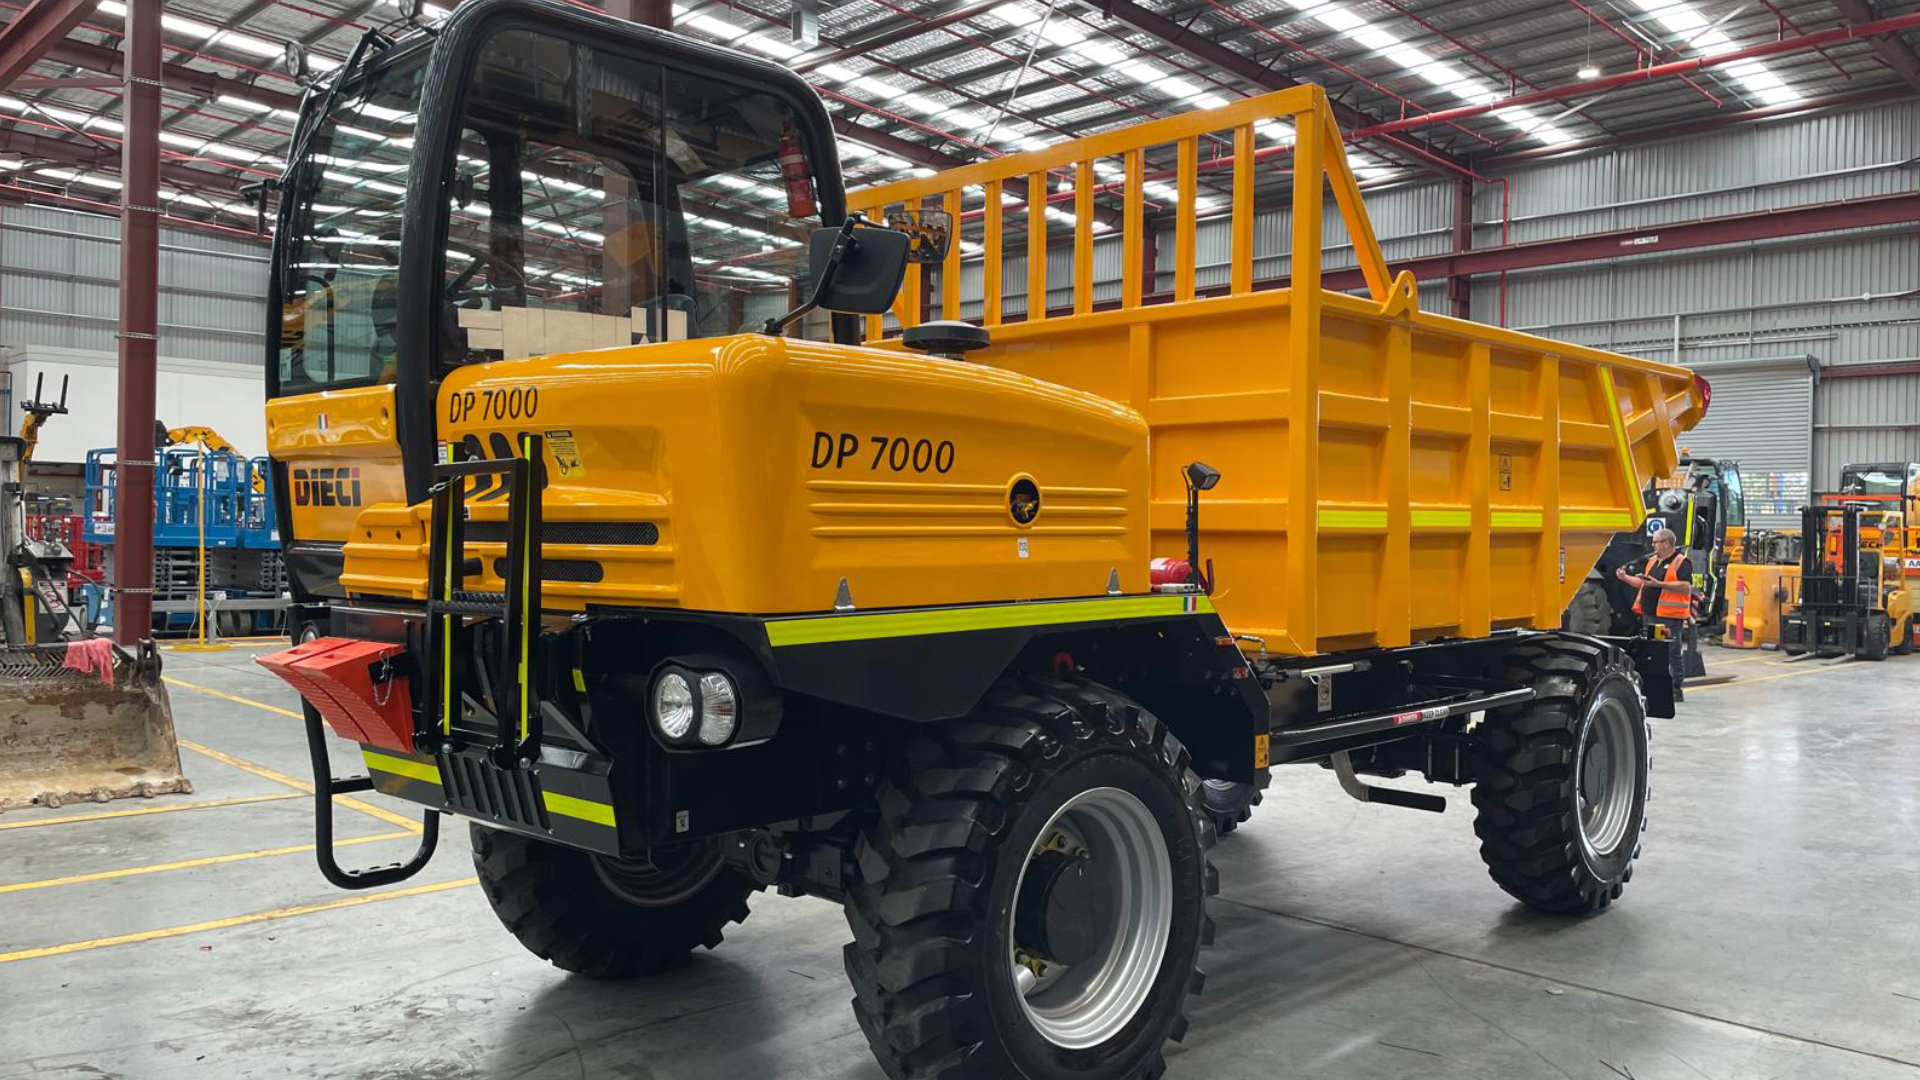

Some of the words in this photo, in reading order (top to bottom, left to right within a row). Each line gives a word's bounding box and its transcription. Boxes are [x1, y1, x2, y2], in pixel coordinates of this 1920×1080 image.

[449, 391, 476, 423] DP
[482, 387, 538, 420] 7000
[811, 431, 859, 469] DP
[870, 436, 955, 474] 7000
